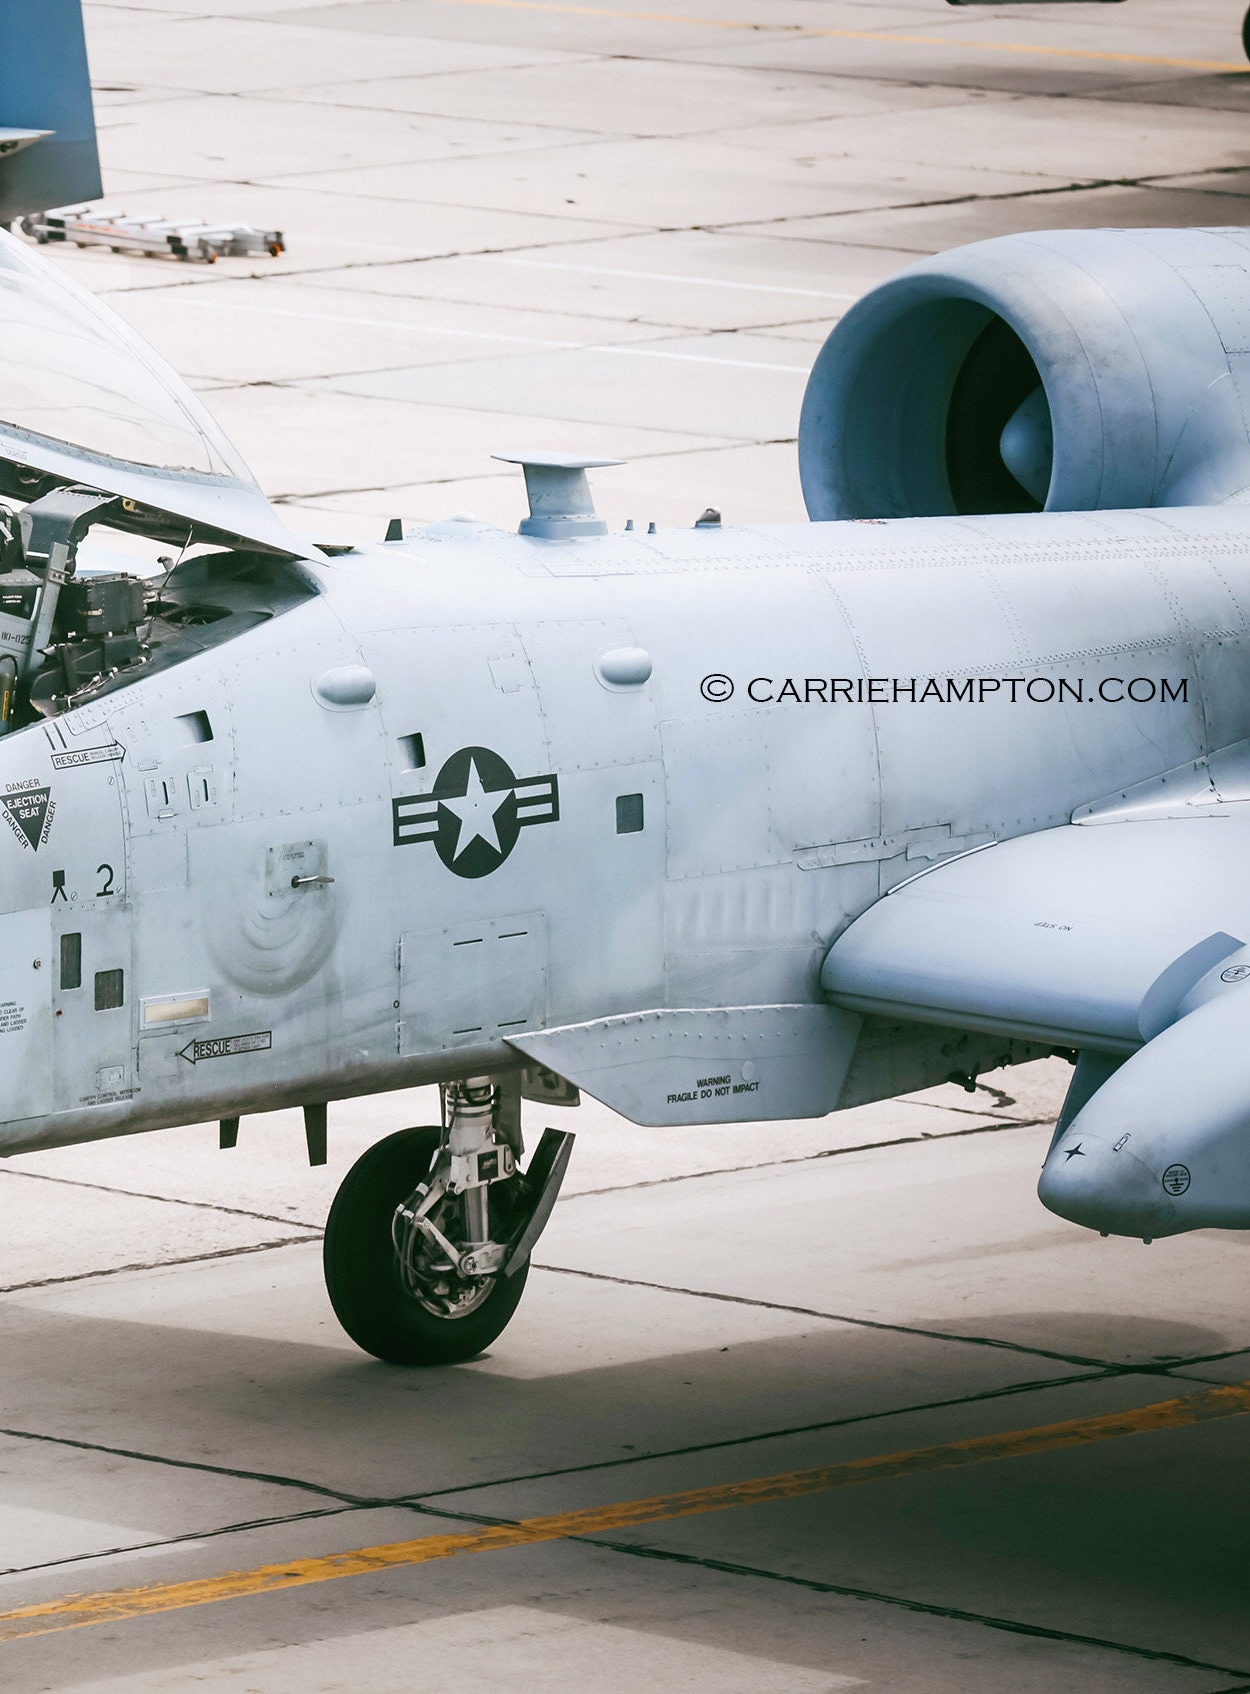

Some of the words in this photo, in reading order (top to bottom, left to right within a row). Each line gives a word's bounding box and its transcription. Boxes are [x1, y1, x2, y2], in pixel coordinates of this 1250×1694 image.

[55, 752, 90, 767] RESCUE
[5, 778, 41, 793] DANGER
[7, 793, 48, 809] EJECTION
[19, 806, 40, 819] SEAT
[1, 809, 29, 850] DANGER
[40, 800, 57, 845] DANGER
[96, 863, 115, 898] 2
[194, 1040, 231, 1058] RESCUE
[696, 1075, 732, 1089] WARNING
[667, 1091, 698, 1104] FRAGILE
[700, 1089, 712, 1099] DO
[714, 1086, 730, 1097] NOT
[732, 1082, 760, 1094] IMPACT
